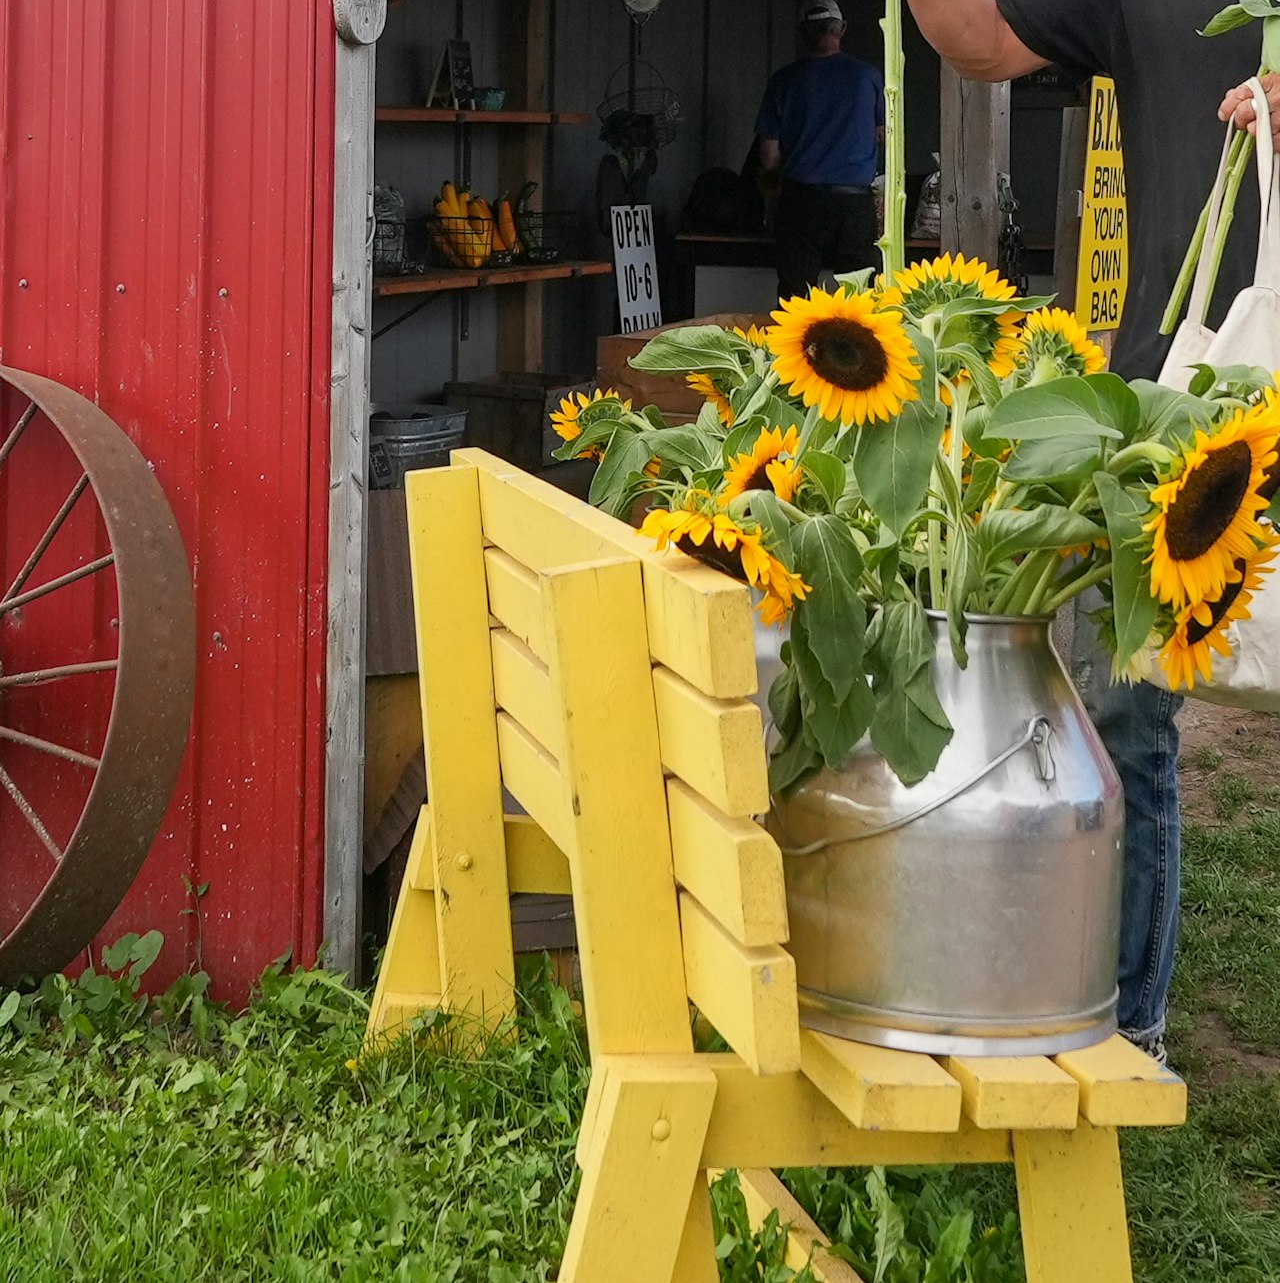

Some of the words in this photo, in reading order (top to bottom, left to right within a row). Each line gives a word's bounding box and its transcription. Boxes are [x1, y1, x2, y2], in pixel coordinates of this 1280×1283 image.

[615, 209, 651, 249] OPEN
[1093, 207, 1124, 241] YOUR
[624, 262, 652, 303] 10-6
[1090, 248, 1121, 284] OWN
[1090, 287, 1118, 324] BAG
